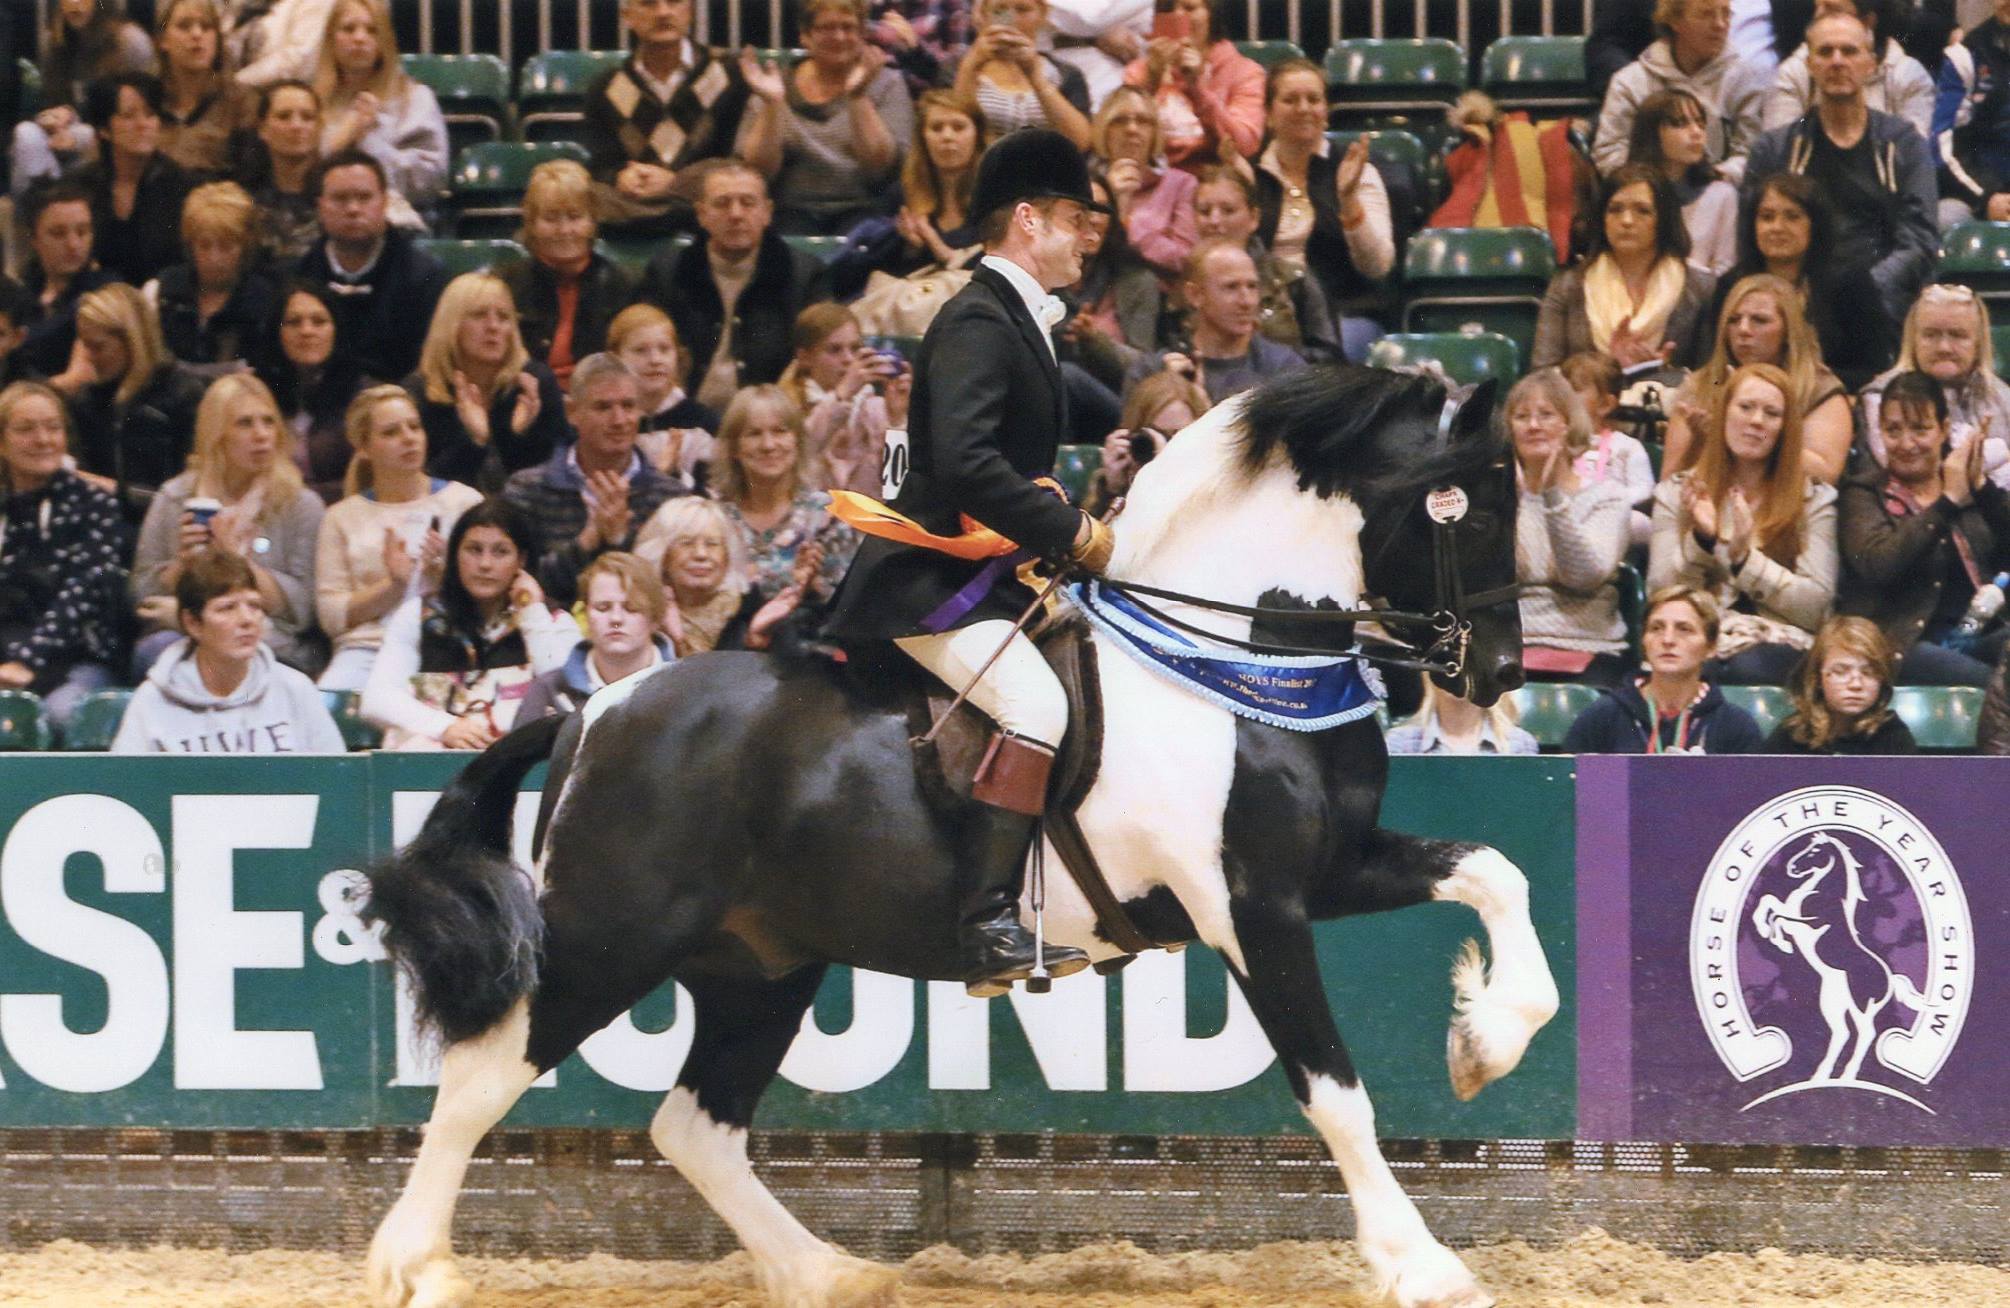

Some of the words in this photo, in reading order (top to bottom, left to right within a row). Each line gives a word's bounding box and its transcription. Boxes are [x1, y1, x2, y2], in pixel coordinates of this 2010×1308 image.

[0, 792, 325, 1094] SE
[311, 868, 391, 966] &
[1707, 906, 1741, 1039] HORSE
[1725, 840, 1756, 882] OF
[1773, 800, 1849, 829] THE
[1876, 813, 1947, 898] YEAR
[1929, 925, 1959, 1037] SHOW
